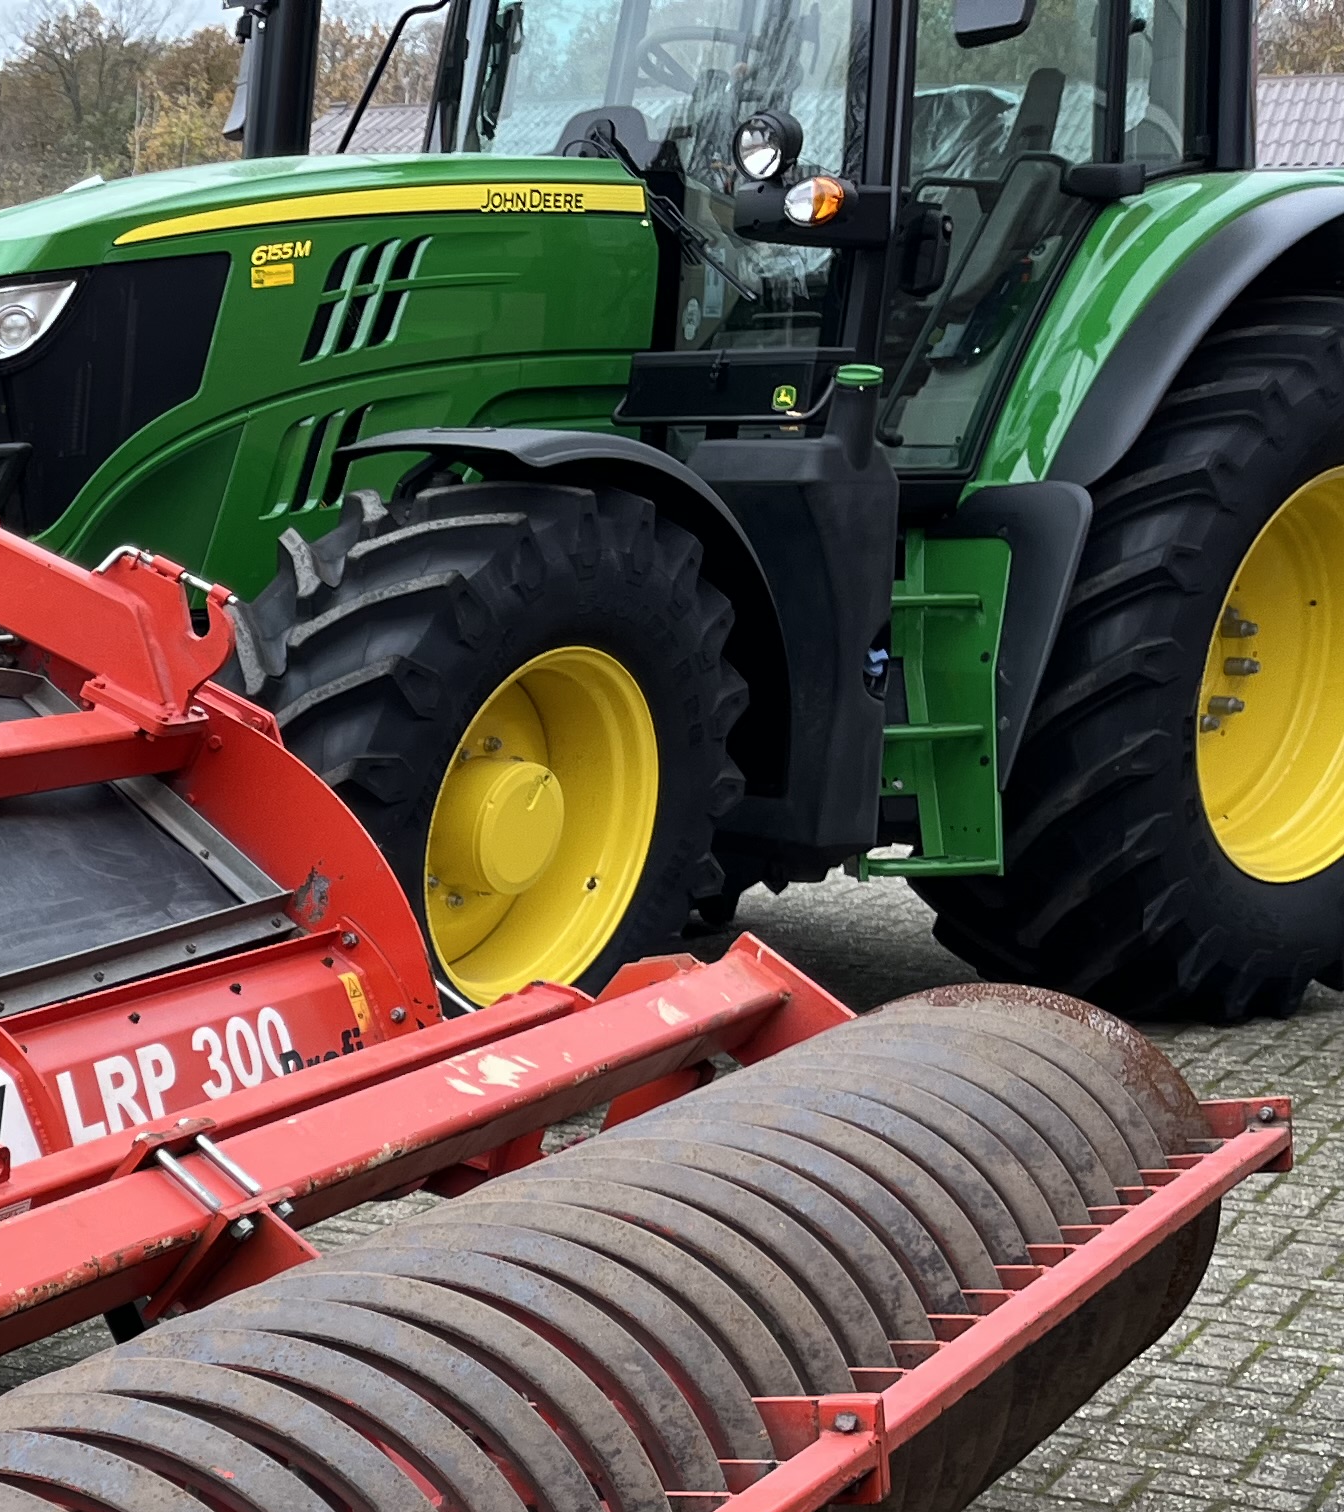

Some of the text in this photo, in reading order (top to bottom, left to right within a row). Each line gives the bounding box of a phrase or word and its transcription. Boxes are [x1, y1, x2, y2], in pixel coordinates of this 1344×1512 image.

[250, 239, 312, 266] 6155M
[56, 1043, 177, 1147] LRP
[191, 1006, 294, 1101] 300
